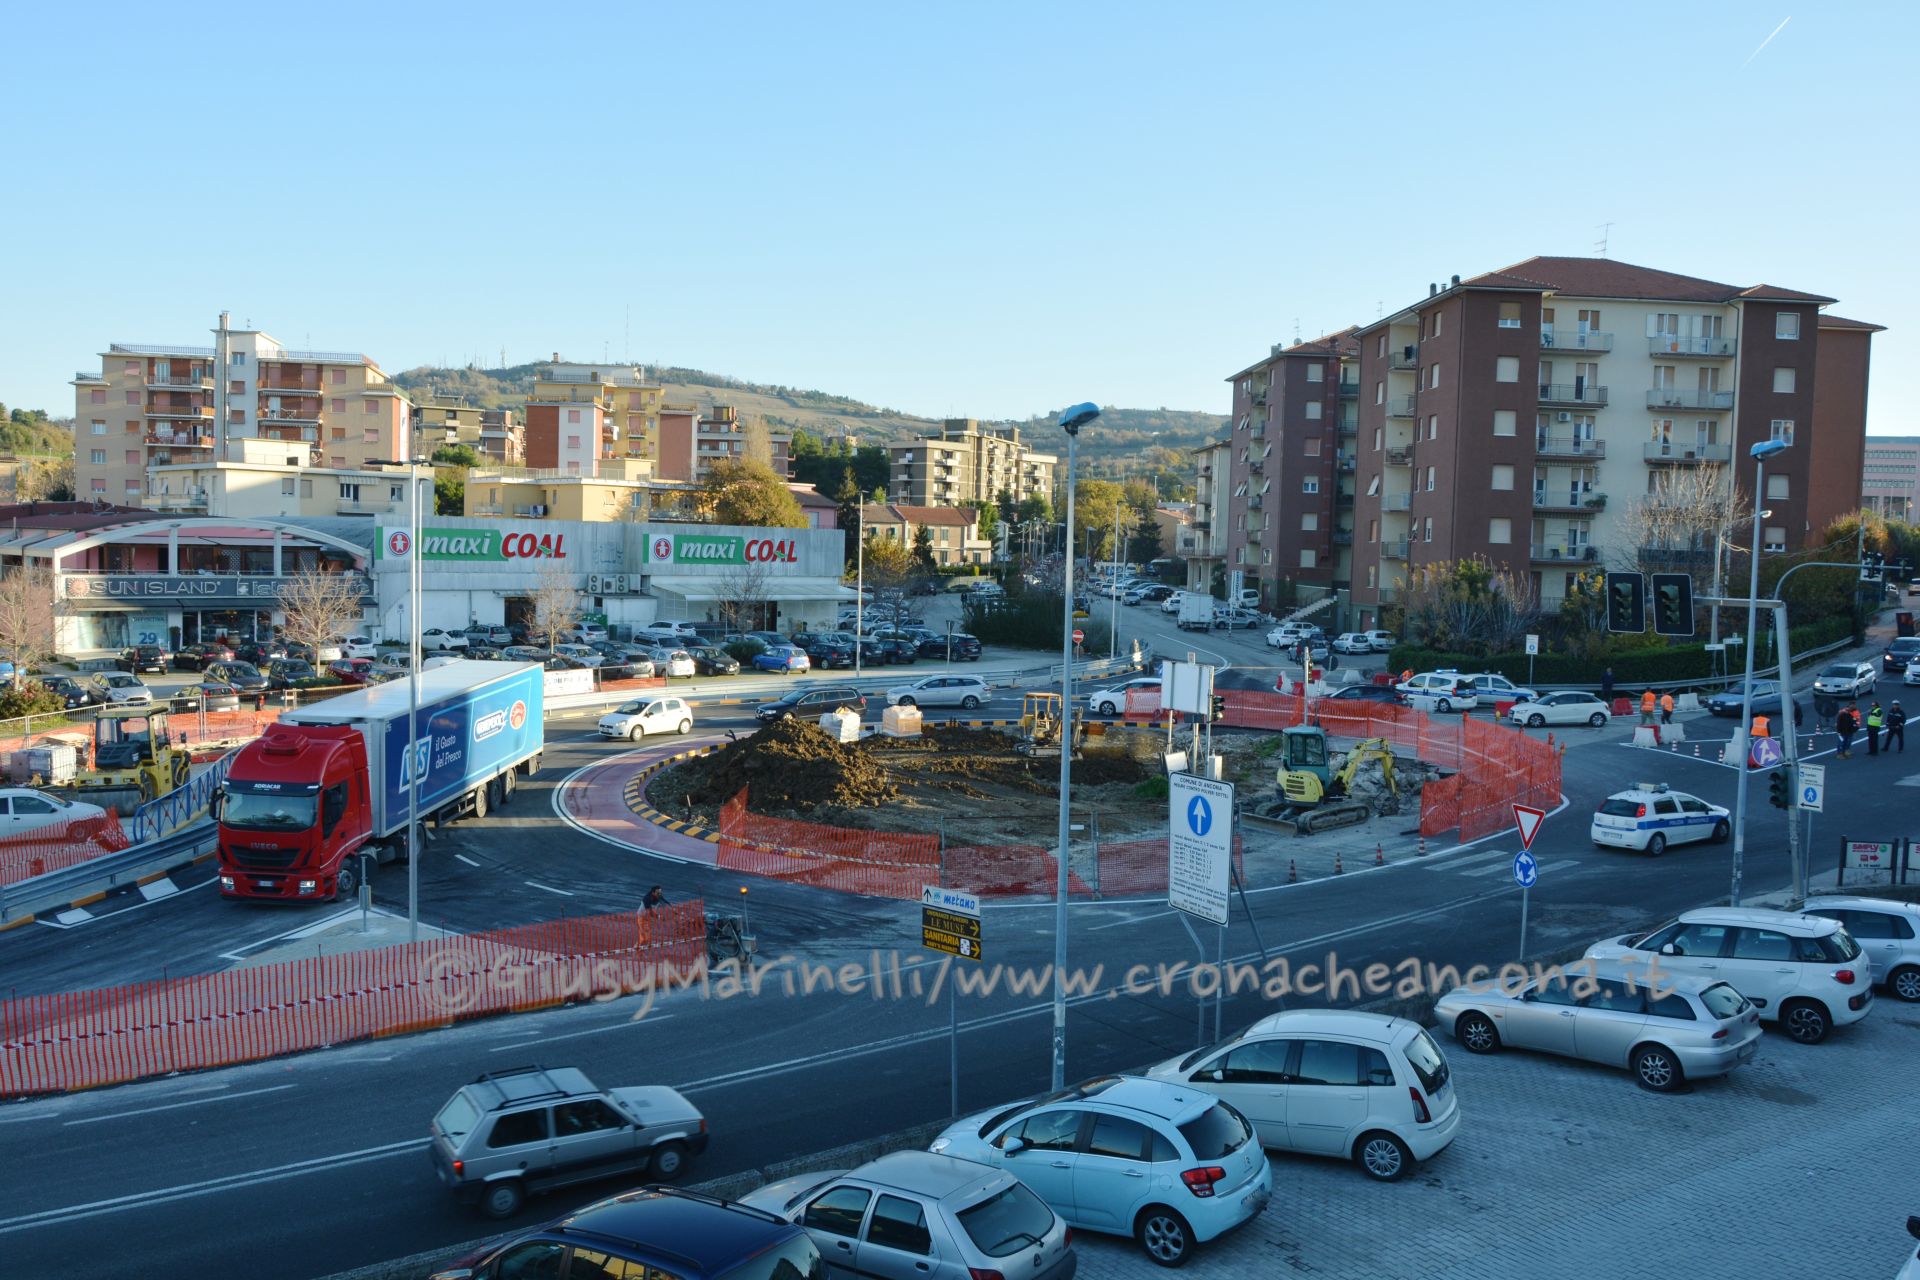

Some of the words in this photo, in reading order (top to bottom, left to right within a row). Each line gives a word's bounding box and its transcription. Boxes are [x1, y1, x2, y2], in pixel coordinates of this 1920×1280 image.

[422, 533, 491, 555] maxi
[502, 533, 567, 558] COAL
[680, 540, 736, 559] maxi
[745, 539, 797, 562] COAL
[90, 580, 139, 595] SUN
[138, 632, 158, 645] 29
[440, 735, 457, 750] Gusto
[445, 750, 462, 765] Fresco
[1180, 777, 1197, 786] COMUNE
[1204, 783, 1222, 791] ANCONA
[944, 894, 975, 910] metano
[931, 917, 941, 928] LE
[943, 921, 966, 934] MUSE
[924, 929, 960, 947] SANITARIA
